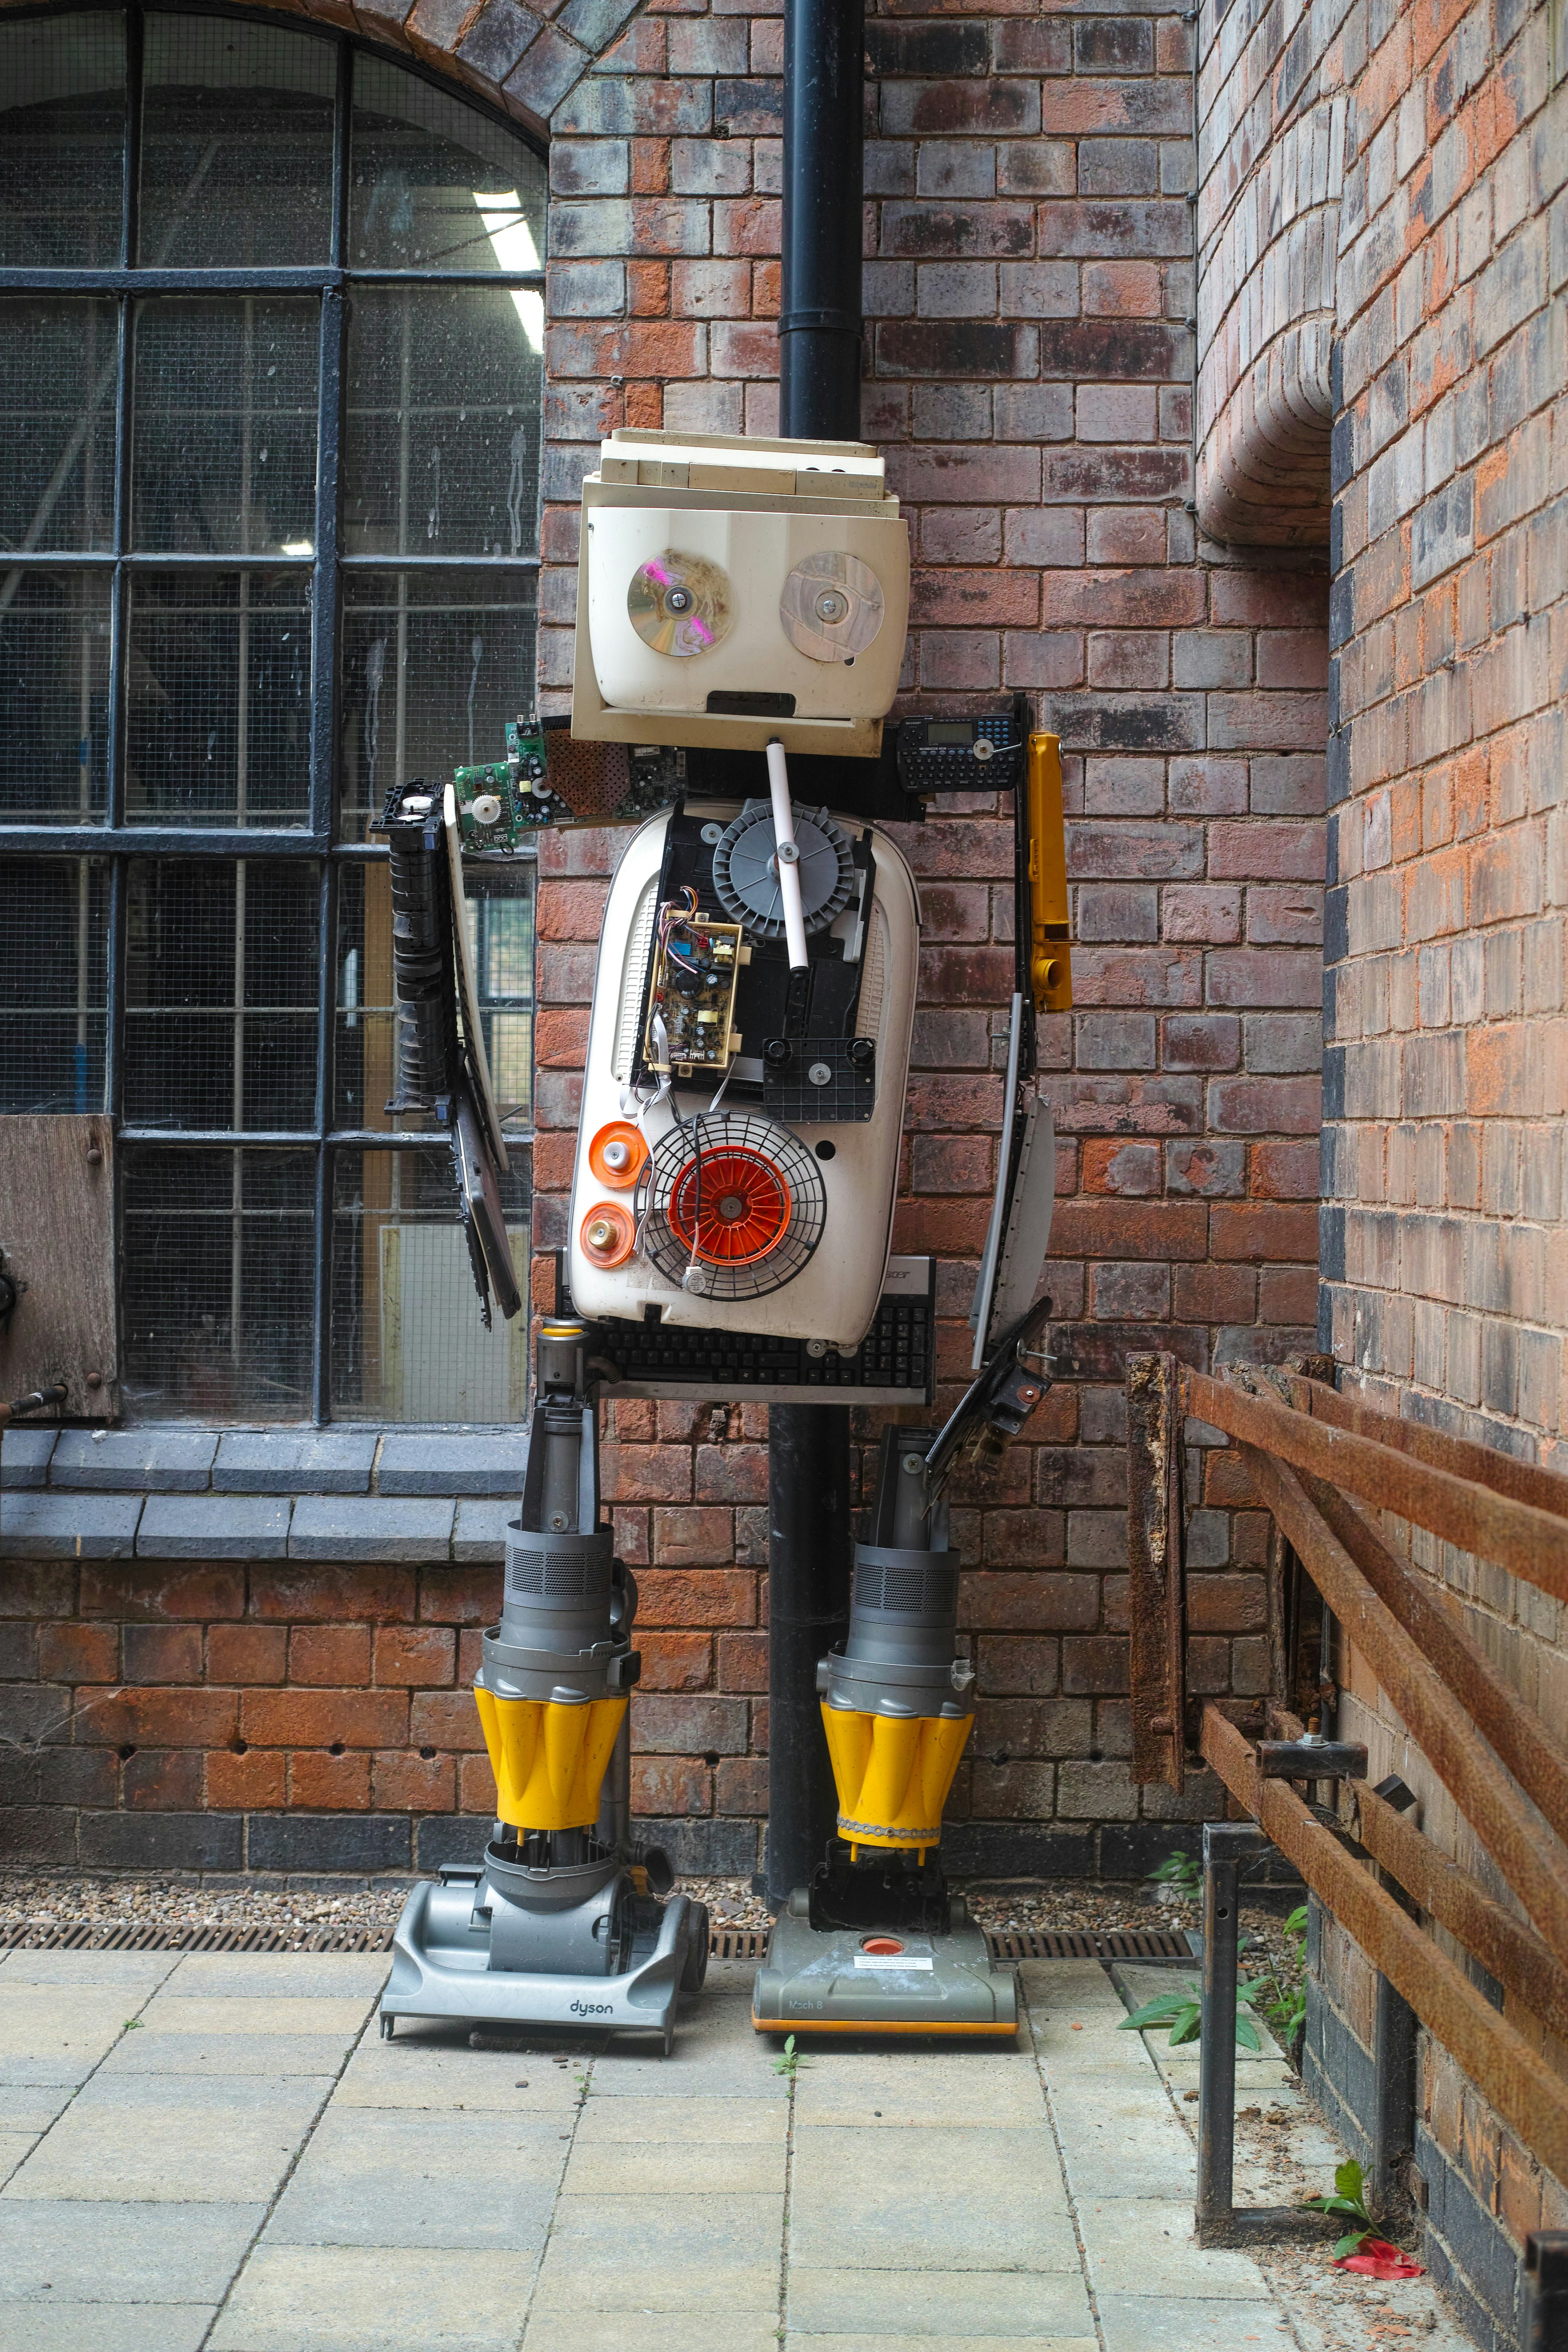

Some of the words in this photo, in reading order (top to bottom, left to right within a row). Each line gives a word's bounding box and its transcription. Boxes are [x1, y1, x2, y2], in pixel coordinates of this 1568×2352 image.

[570, 2000, 613, 2016] dyson
[789, 2000, 814, 2009] Mach
[816, 2000, 822, 2010] 8
